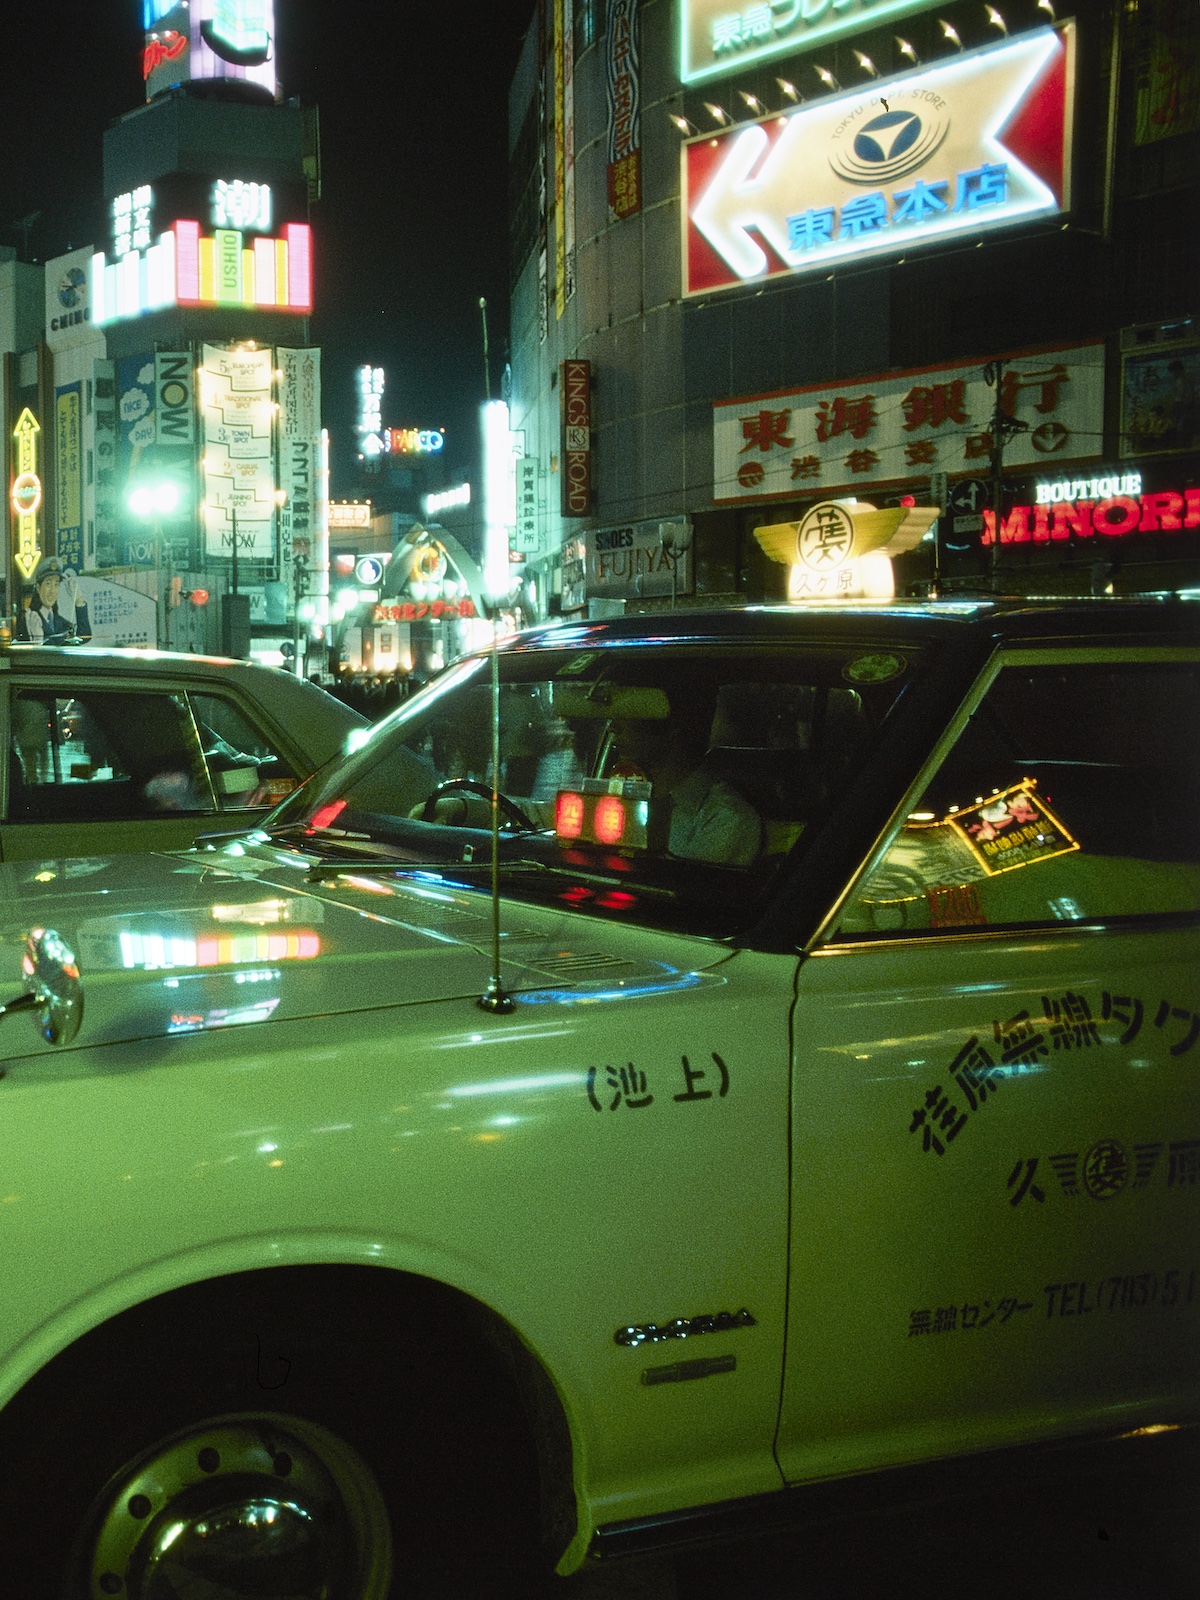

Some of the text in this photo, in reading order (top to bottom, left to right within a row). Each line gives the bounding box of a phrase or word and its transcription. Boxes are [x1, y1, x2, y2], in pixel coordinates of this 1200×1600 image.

[832, 107, 864, 141] TOKYU
[911, 88, 946, 111] STORE
[787, 163, 1008, 251] 東急本店
[223, 234, 237, 288] USHIO
[159, 357, 189, 438] NOW
[738, 364, 1070, 455] 東海銀行
[391, 429, 444, 452] PARCO
[790, 431, 996, 481] 渋谷支店
[568, 453, 587, 513] ROAD
[1035, 474, 1142, 504] BOUTIQUE
[221, 532, 256, 548] NOW
[596, 528, 634, 549] SHOES
[599, 549, 673, 580] FUJIYA
[587, 1053, 728, 1112] (池上)
[1044, 1281, 1093, 1318] TEL
